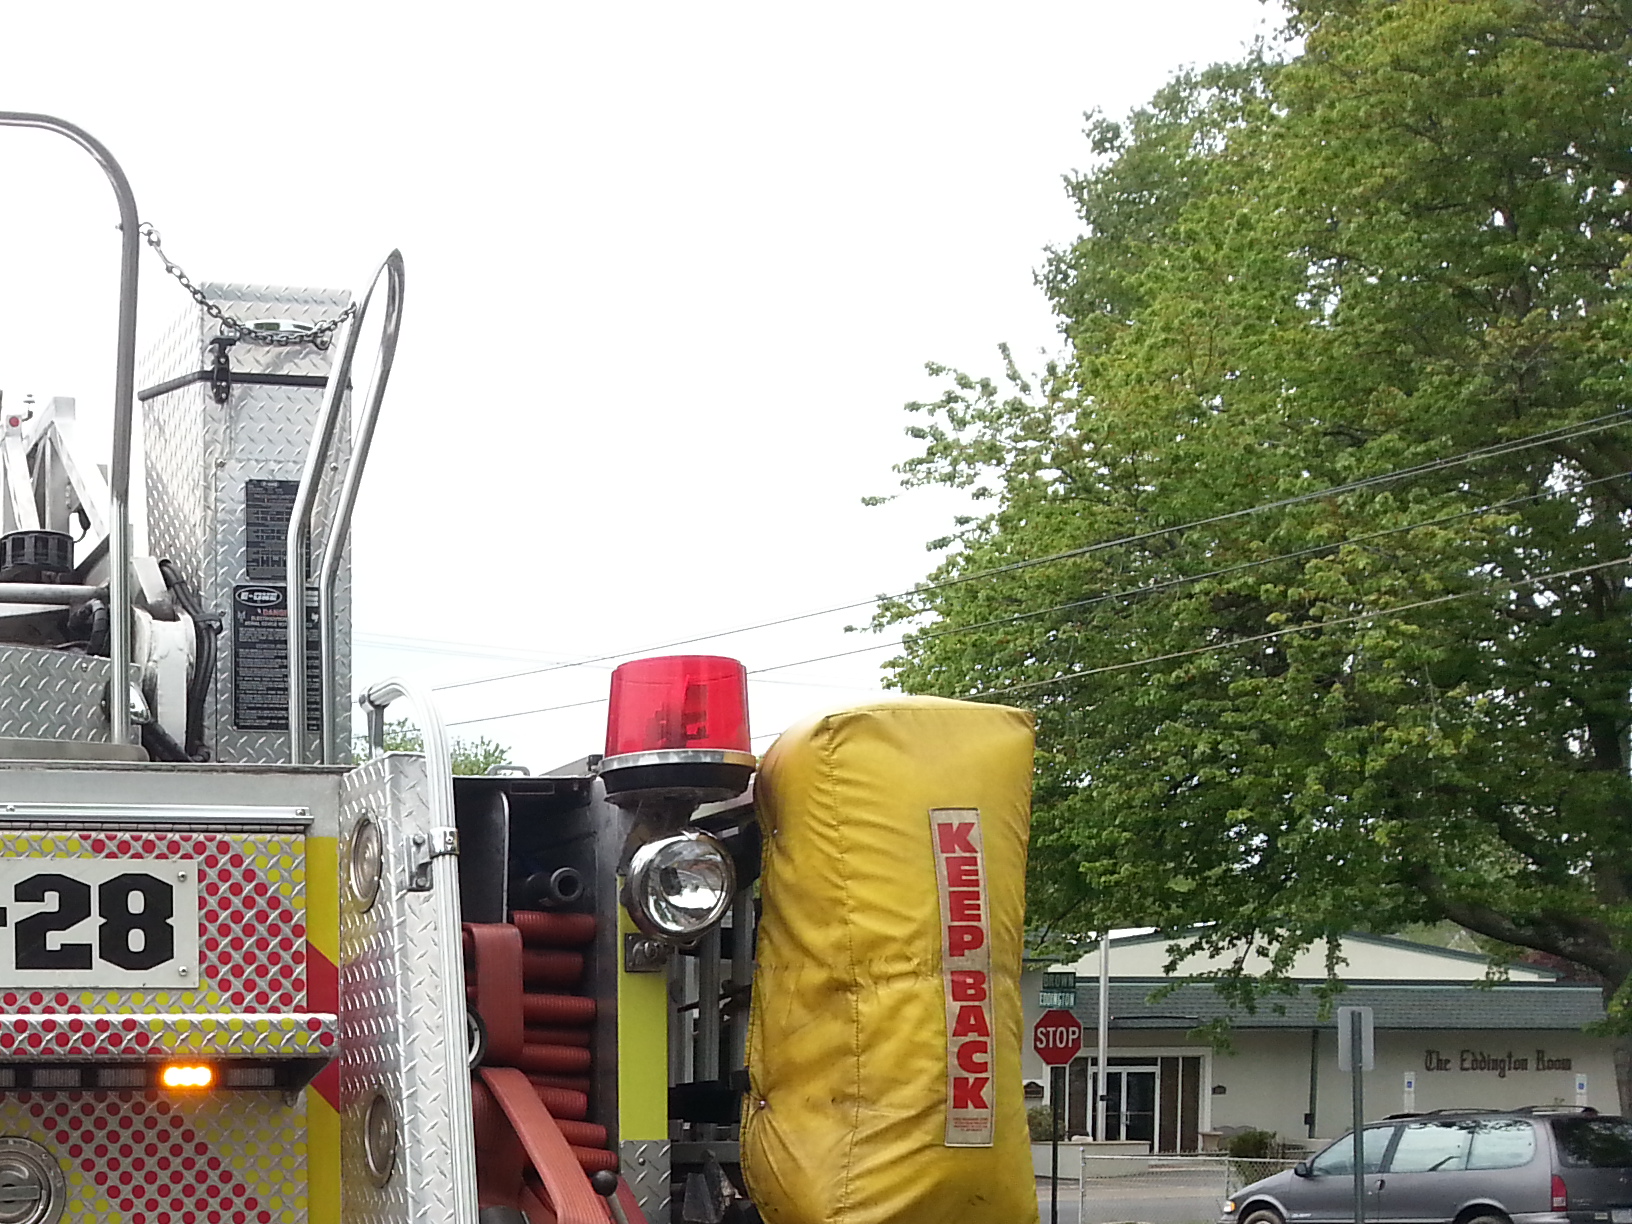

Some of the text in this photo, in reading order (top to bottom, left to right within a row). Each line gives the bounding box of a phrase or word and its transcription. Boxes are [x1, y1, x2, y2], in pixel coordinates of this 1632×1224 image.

[937, 822, 984, 958] KEEP
[1043, 974, 1074, 987] BROWN
[949, 970, 991, 1110] BACK
[1036, 1026, 1080, 1049] STOP
[1424, 1050, 1572, 1078] The Eddington Room
